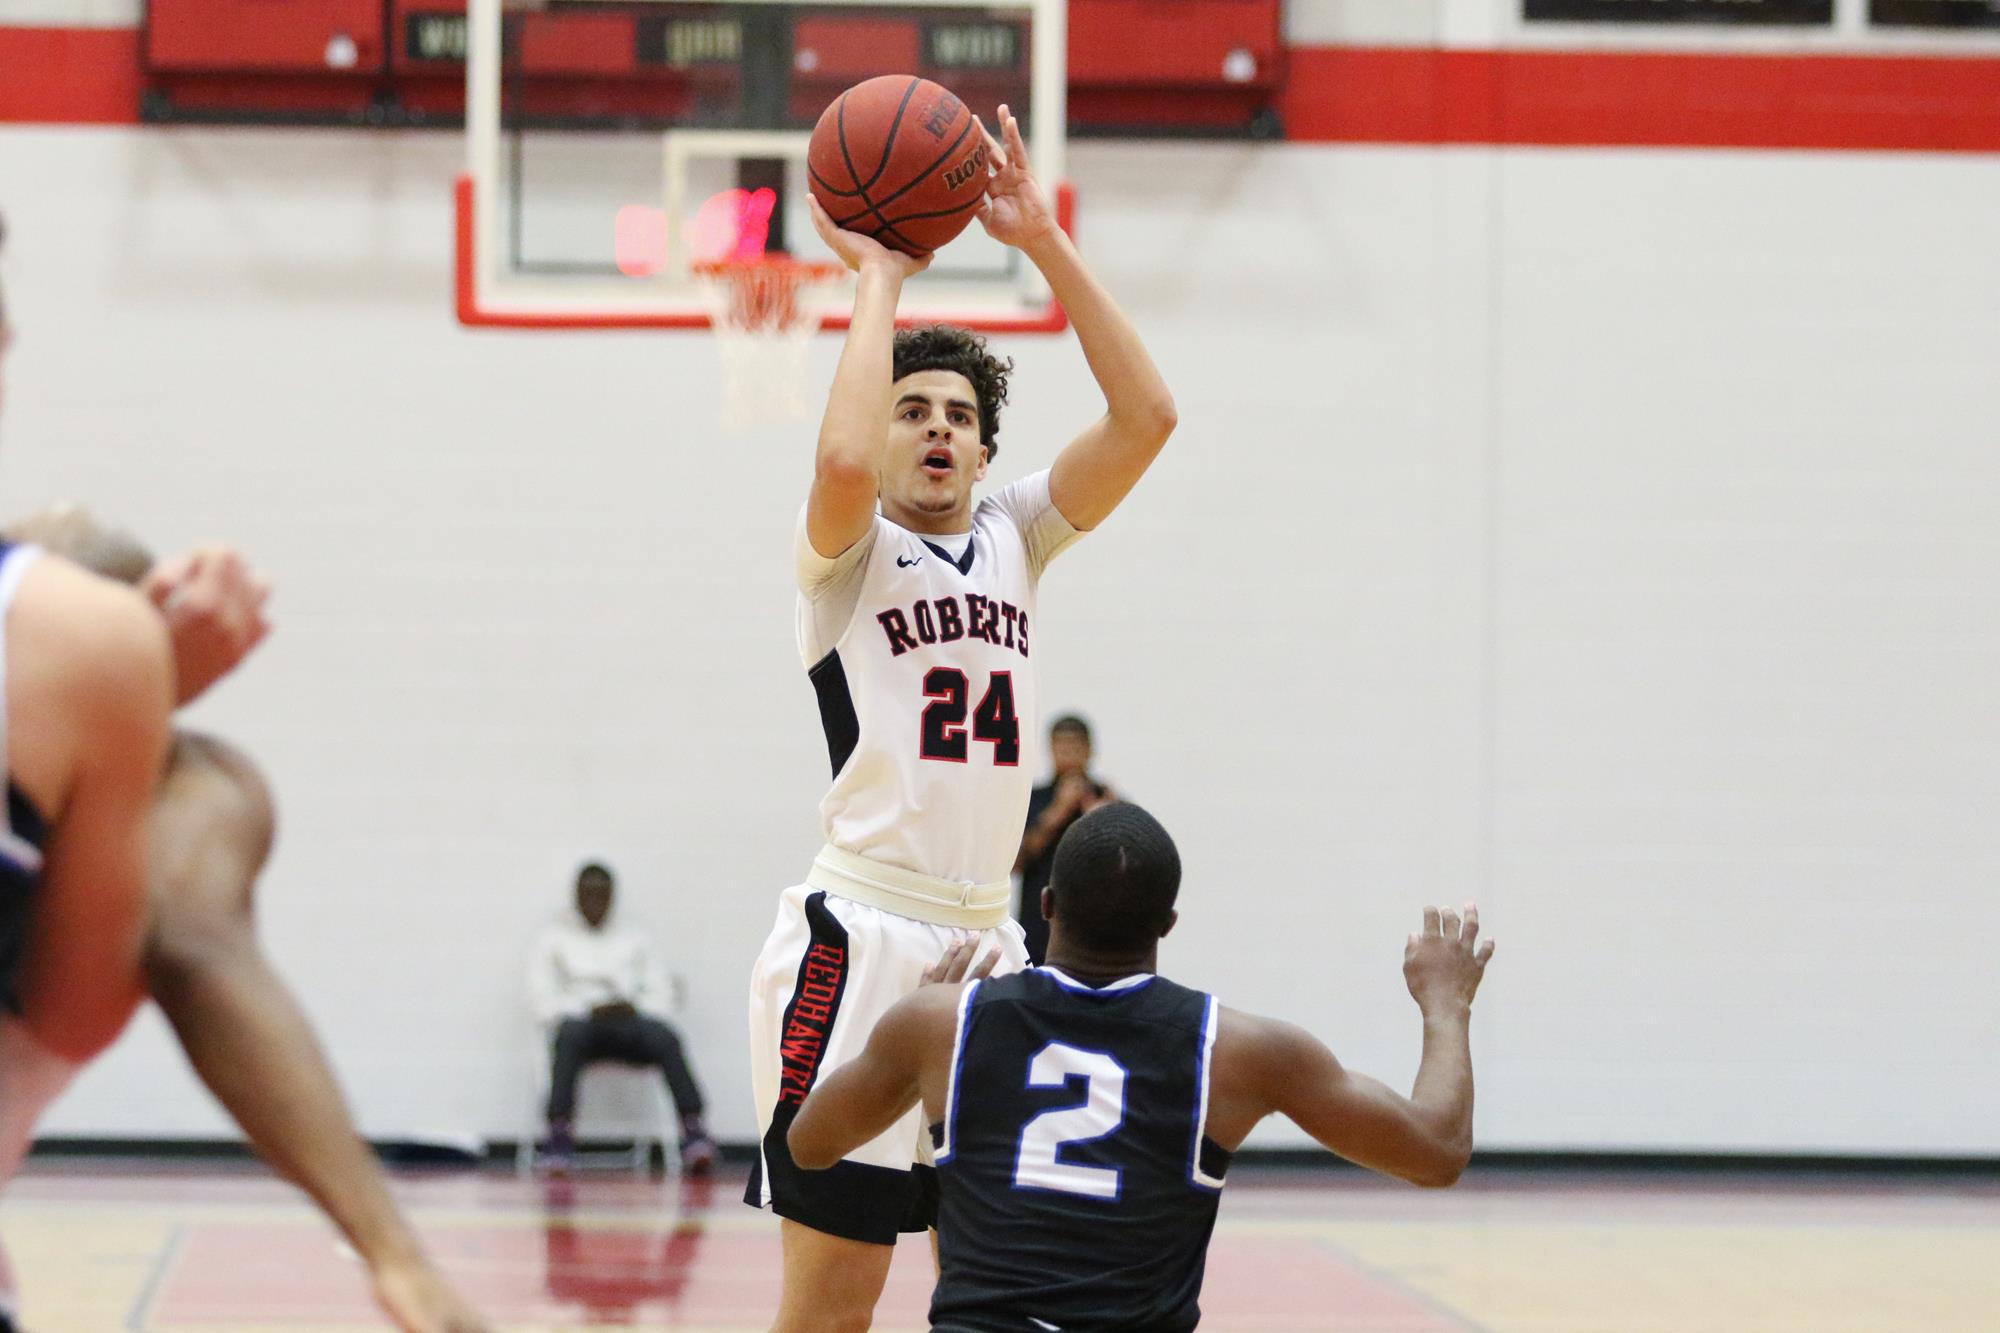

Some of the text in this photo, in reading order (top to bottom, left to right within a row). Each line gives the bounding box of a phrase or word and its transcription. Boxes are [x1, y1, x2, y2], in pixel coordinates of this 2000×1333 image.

[876, 592, 1029, 658] ROBERTS
[919, 666, 1020, 767] 24
[1010, 1039, 1130, 1203] 2
